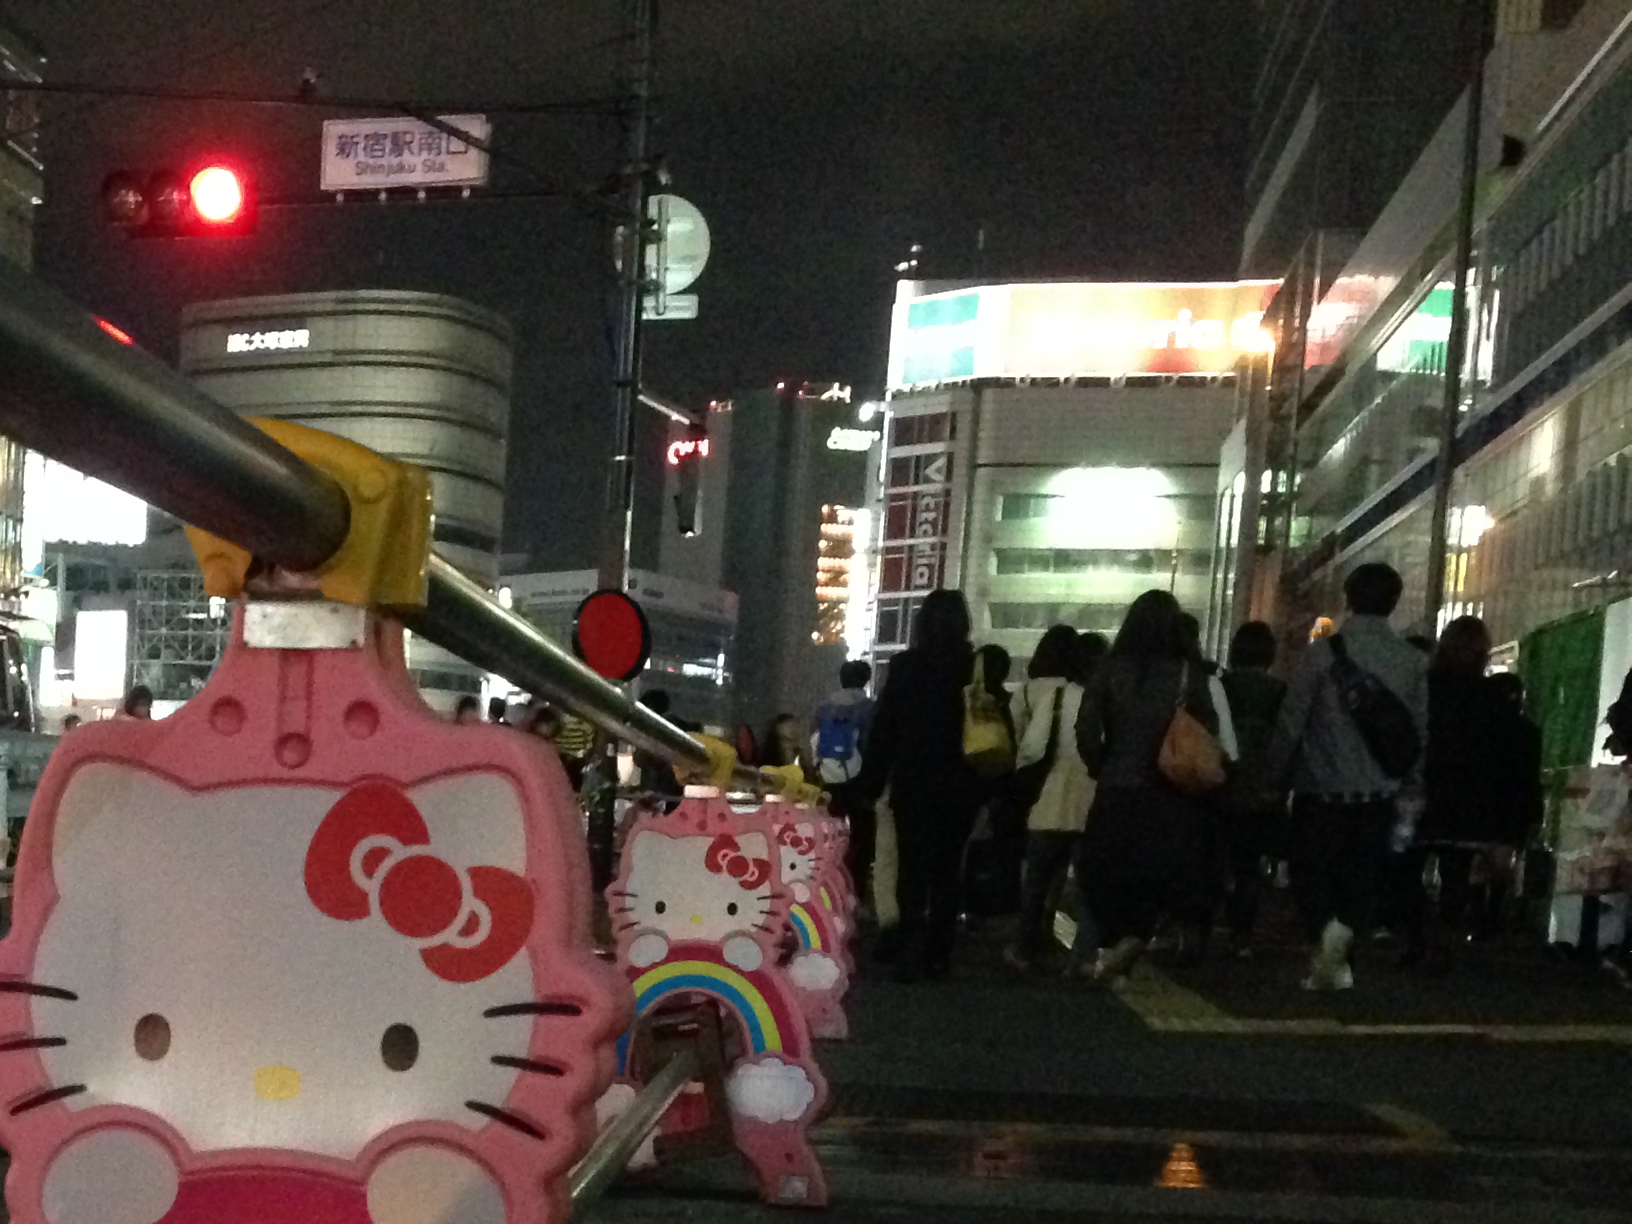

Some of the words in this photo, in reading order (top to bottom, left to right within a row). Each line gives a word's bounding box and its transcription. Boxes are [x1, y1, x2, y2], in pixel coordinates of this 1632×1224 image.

[335, 130, 468, 159] 新宿駅南口
[355, 160, 417, 177] Shinjuku
